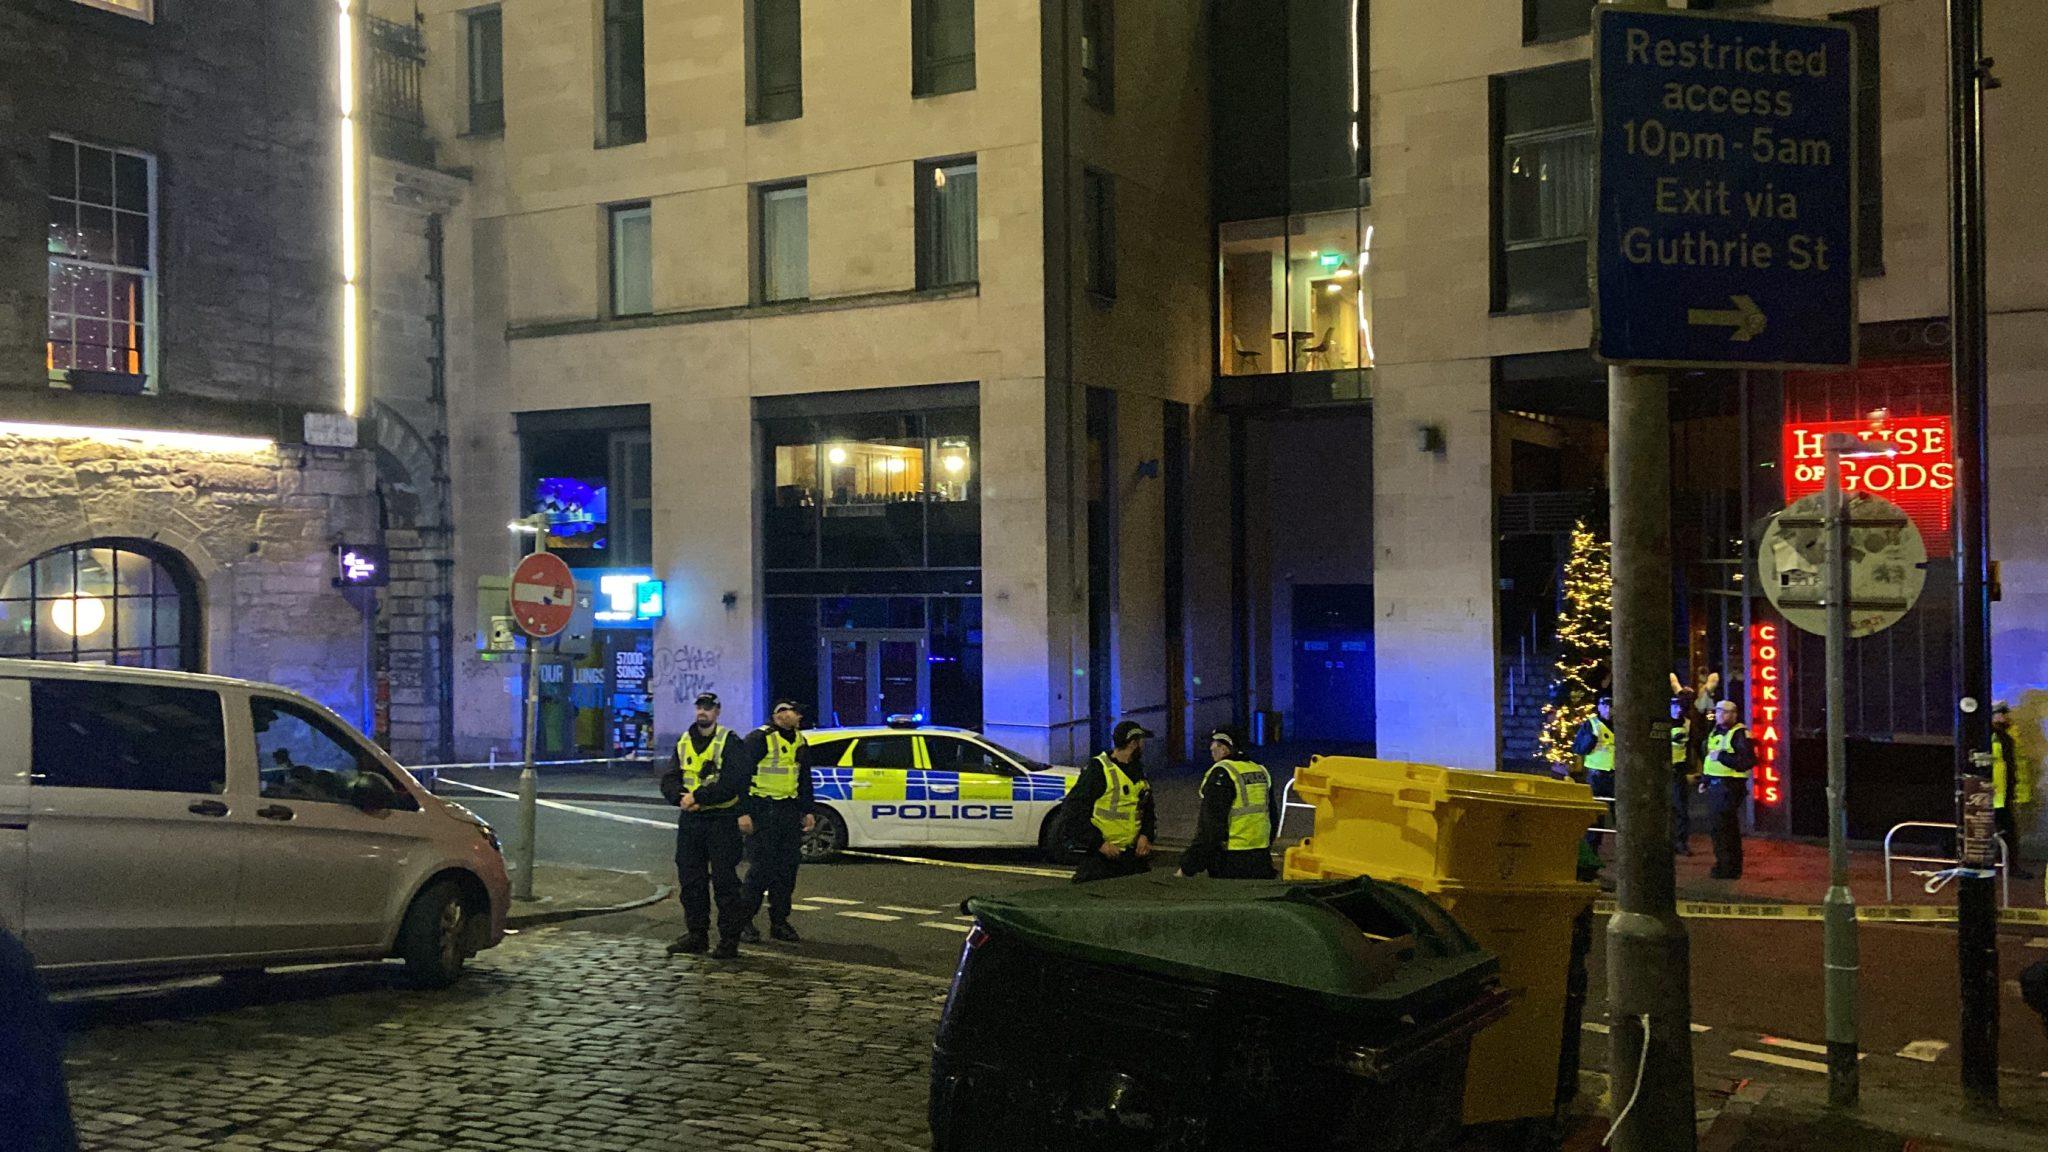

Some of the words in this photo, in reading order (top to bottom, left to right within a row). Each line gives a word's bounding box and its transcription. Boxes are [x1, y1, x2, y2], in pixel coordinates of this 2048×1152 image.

[1625, 28, 1828, 77] Restricted
[1662, 81, 1793, 117] access
[1655, 177, 1730, 215] Exit
[1745, 183, 1797, 219] via
[1620, 226, 1772, 269] Guthrie
[1786, 234, 1829, 271] St
[1793, 428, 1944, 459] HSE
[1838, 461, 1953, 491] GODS
[539, 664, 564, 683] OUR
[572, 668, 605, 684] LUNGS
[616, 666, 646, 679] SONGS
[1759, 625, 1779, 802] COCKTAILS
[872, 805, 1013, 820] POLICE
